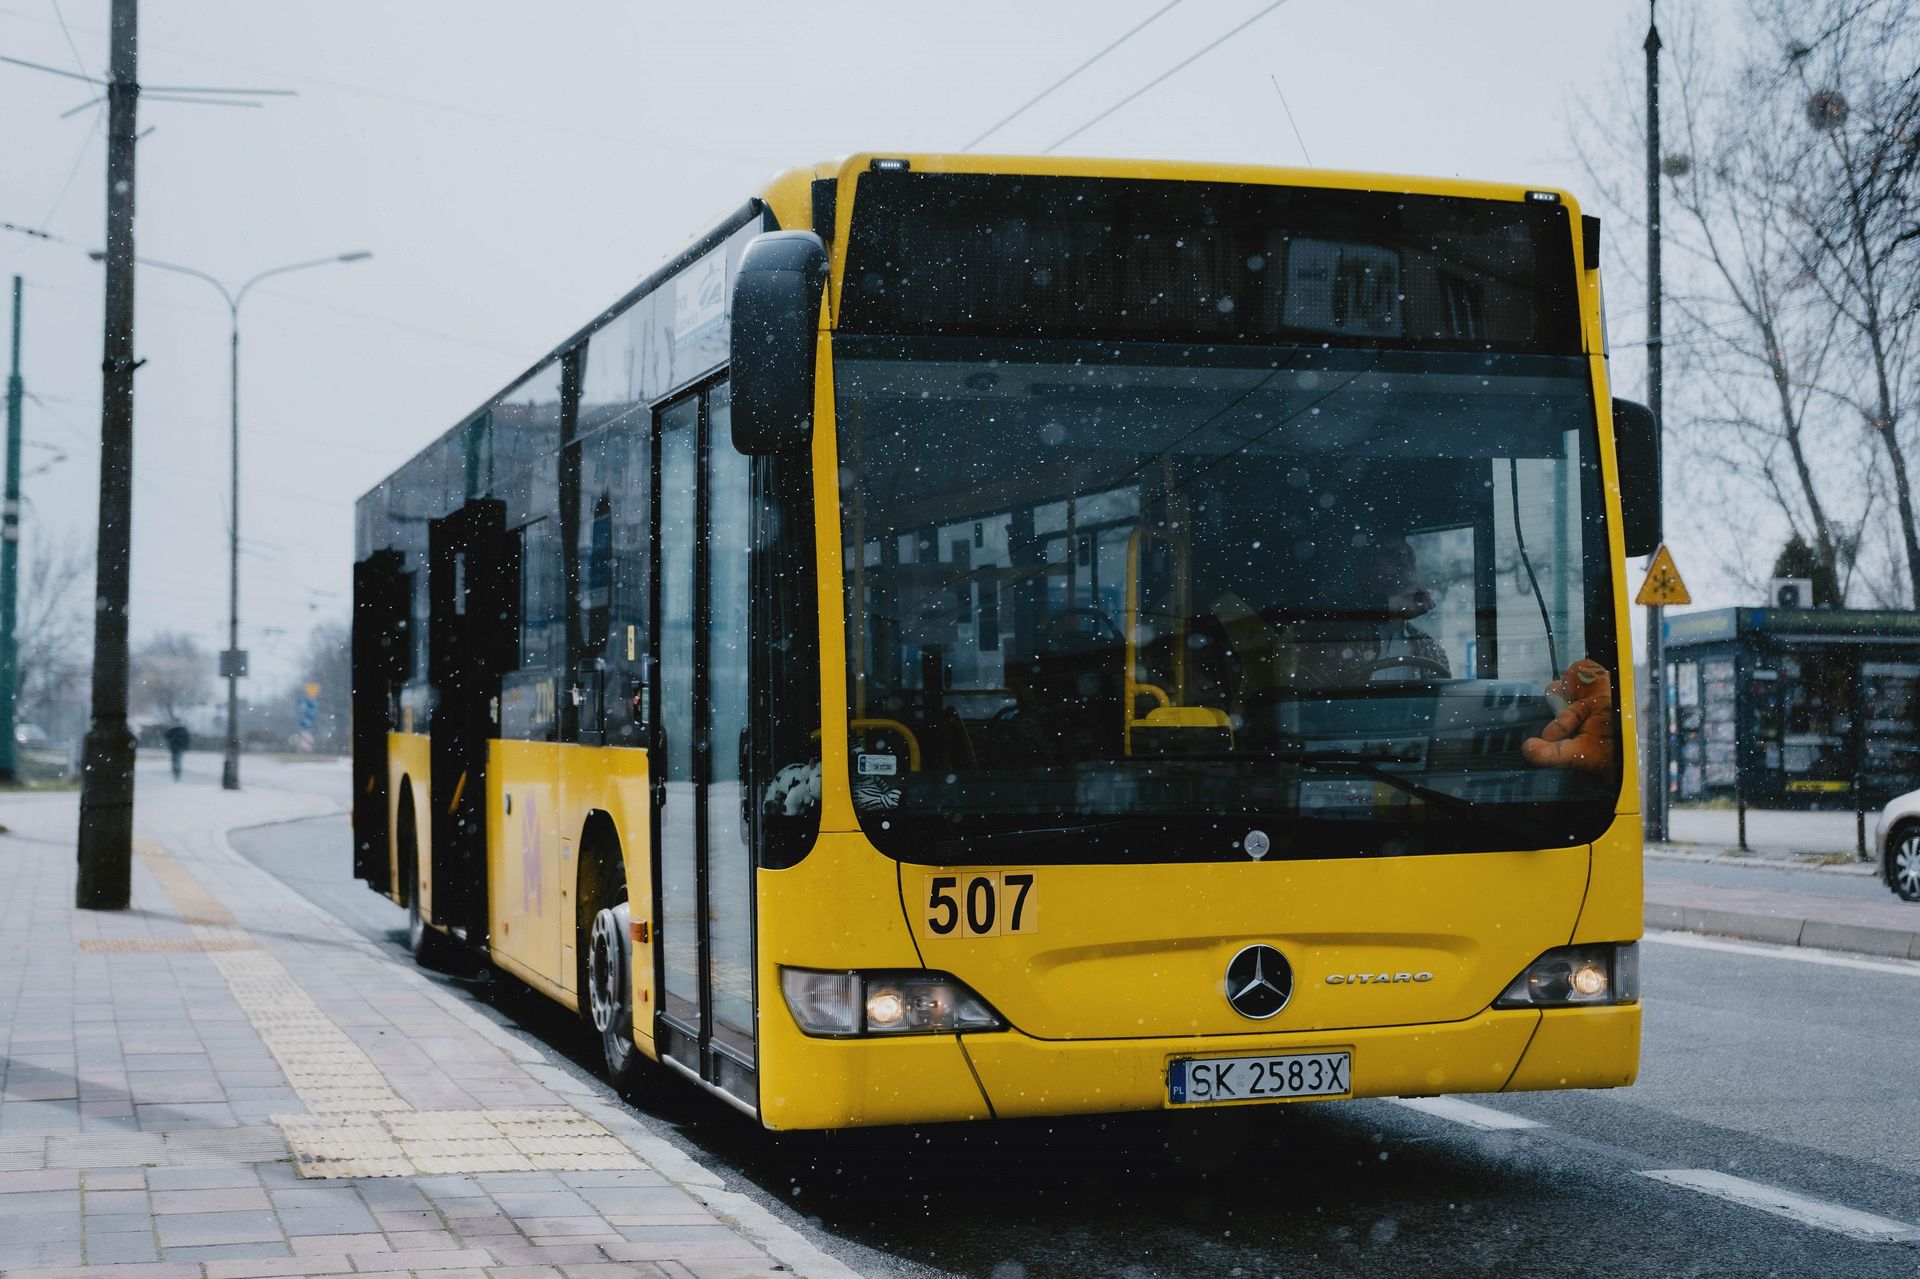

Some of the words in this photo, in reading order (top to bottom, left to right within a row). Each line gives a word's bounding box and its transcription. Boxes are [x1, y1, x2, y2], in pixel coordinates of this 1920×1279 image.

[928, 875, 1033, 934] 507
[1325, 972, 1433, 984] CITARO
[1192, 1063, 1235, 1096] SK
[1249, 1058, 1343, 1094] 2583X
[1173, 1086, 1184, 1095] PL
